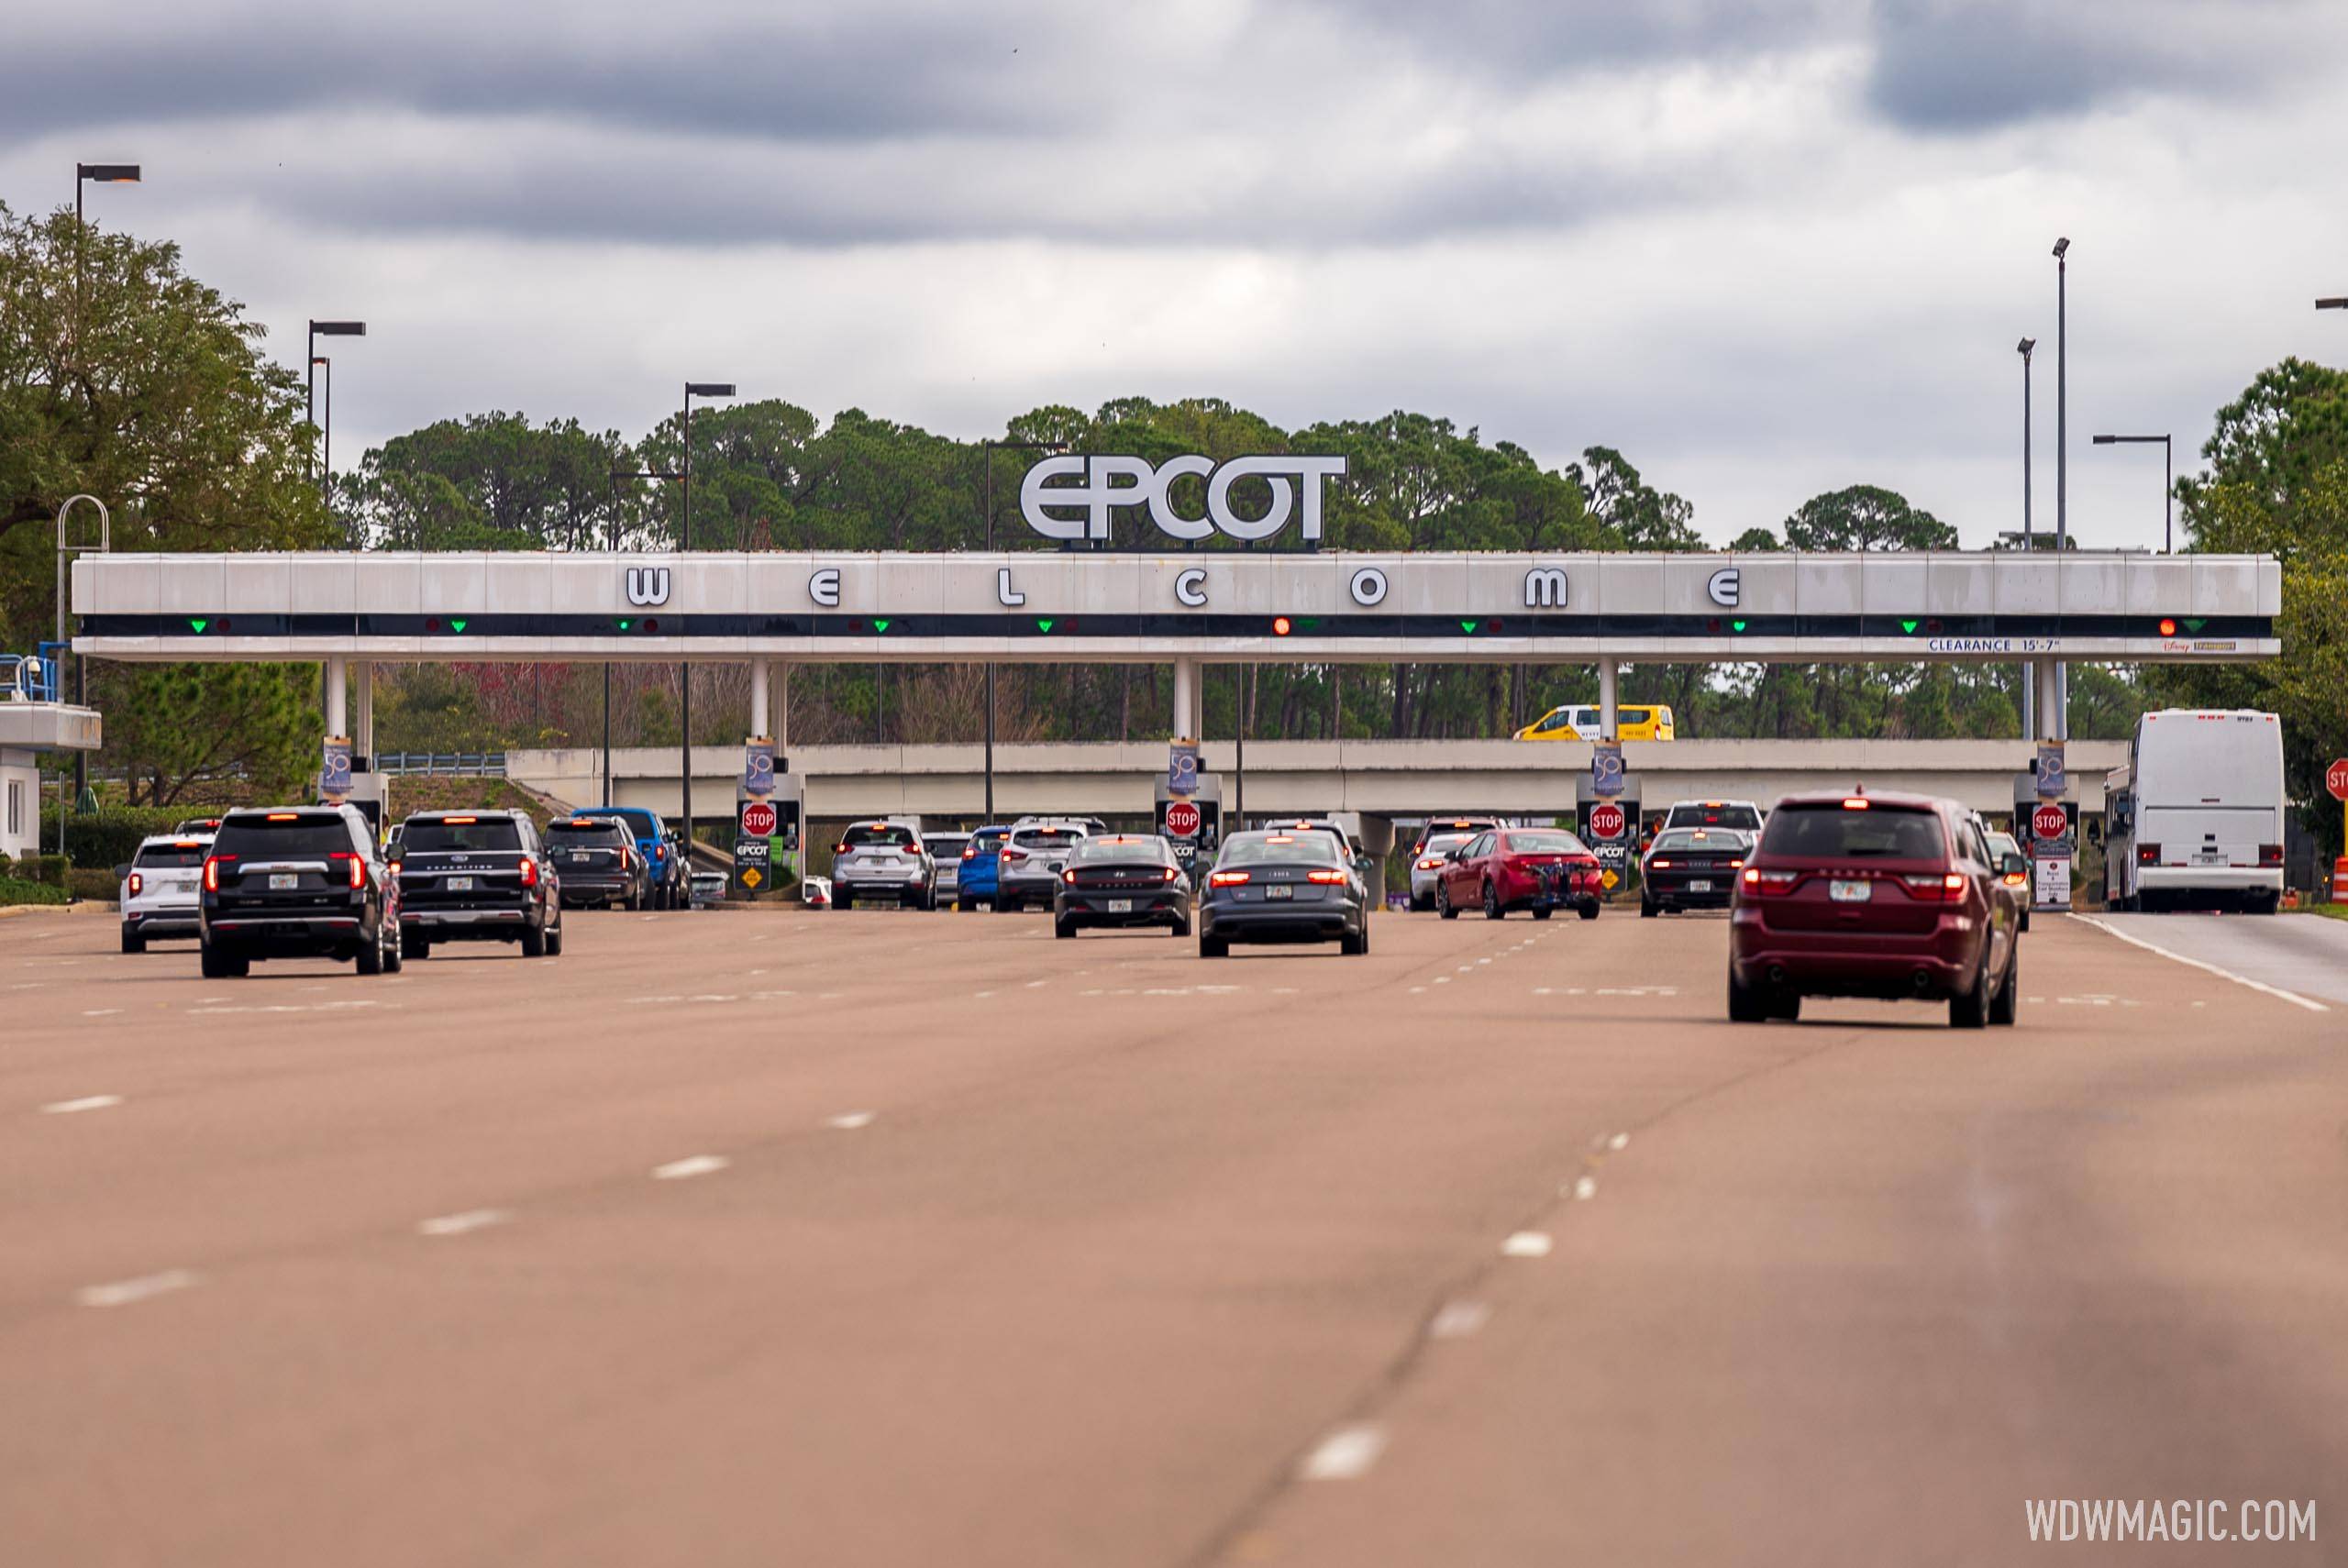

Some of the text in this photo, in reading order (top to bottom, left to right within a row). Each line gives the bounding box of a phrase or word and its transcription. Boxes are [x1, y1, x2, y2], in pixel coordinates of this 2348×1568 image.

[1019, 454, 1349, 541] EPCOT
[626, 568, 1741, 607] WELCOME
[1929, 639, 2010, 652] CLEARANCE
[2330, 771, 2348, 789] ST
[745, 812, 774, 826] STOP
[1168, 812, 1198, 826] STOP
[1592, 814, 1622, 828] STOP
[2035, 814, 2065, 829] STOP
[737, 845, 769, 856] EPCOT
[1593, 846, 1625, 857] EPCOT
